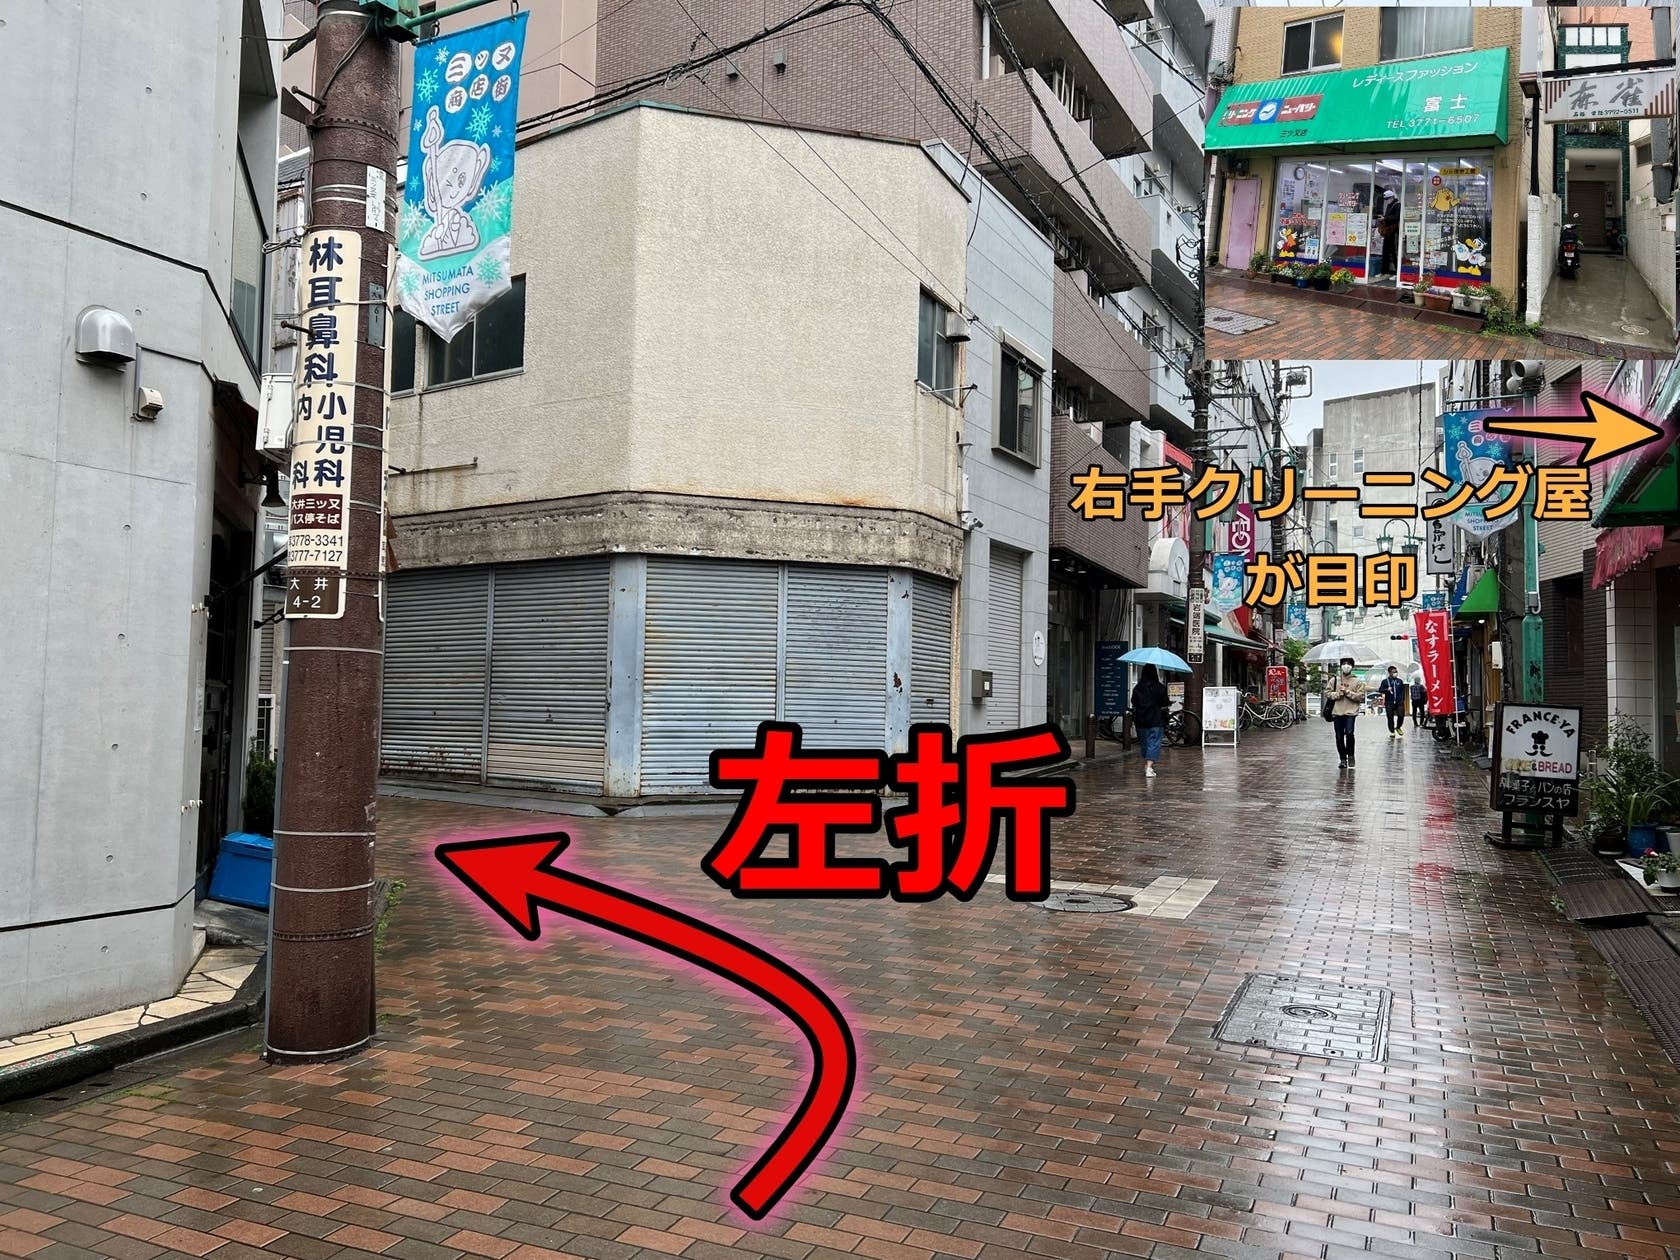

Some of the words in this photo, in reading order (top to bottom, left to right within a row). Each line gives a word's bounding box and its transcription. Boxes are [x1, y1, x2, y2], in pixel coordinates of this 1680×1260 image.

[1352, 62, 1479, 88] レディースファッション
[448, 77, 509, 108] 商店街
[1569, 78, 1644, 110] 麻雀
[1423, 94, 1468, 112] 富士
[1386, 119, 1406, 129] TEL
[422, 265, 474, 285] MITSUMATA
[424, 283, 470, 301] SHOPPING
[304, 236, 343, 388] 林耳鼻科
[431, 301, 460, 317] STREET
[314, 391, 347, 488] 小児科
[291, 498, 341, 510] 大井三ツ又
[289, 577, 329, 591] 大井
[292, 595, 322, 609] 4-2
[1425, 619, 1443, 708] なすラーメン
[1503, 793, 1570, 809] フランスヤ
